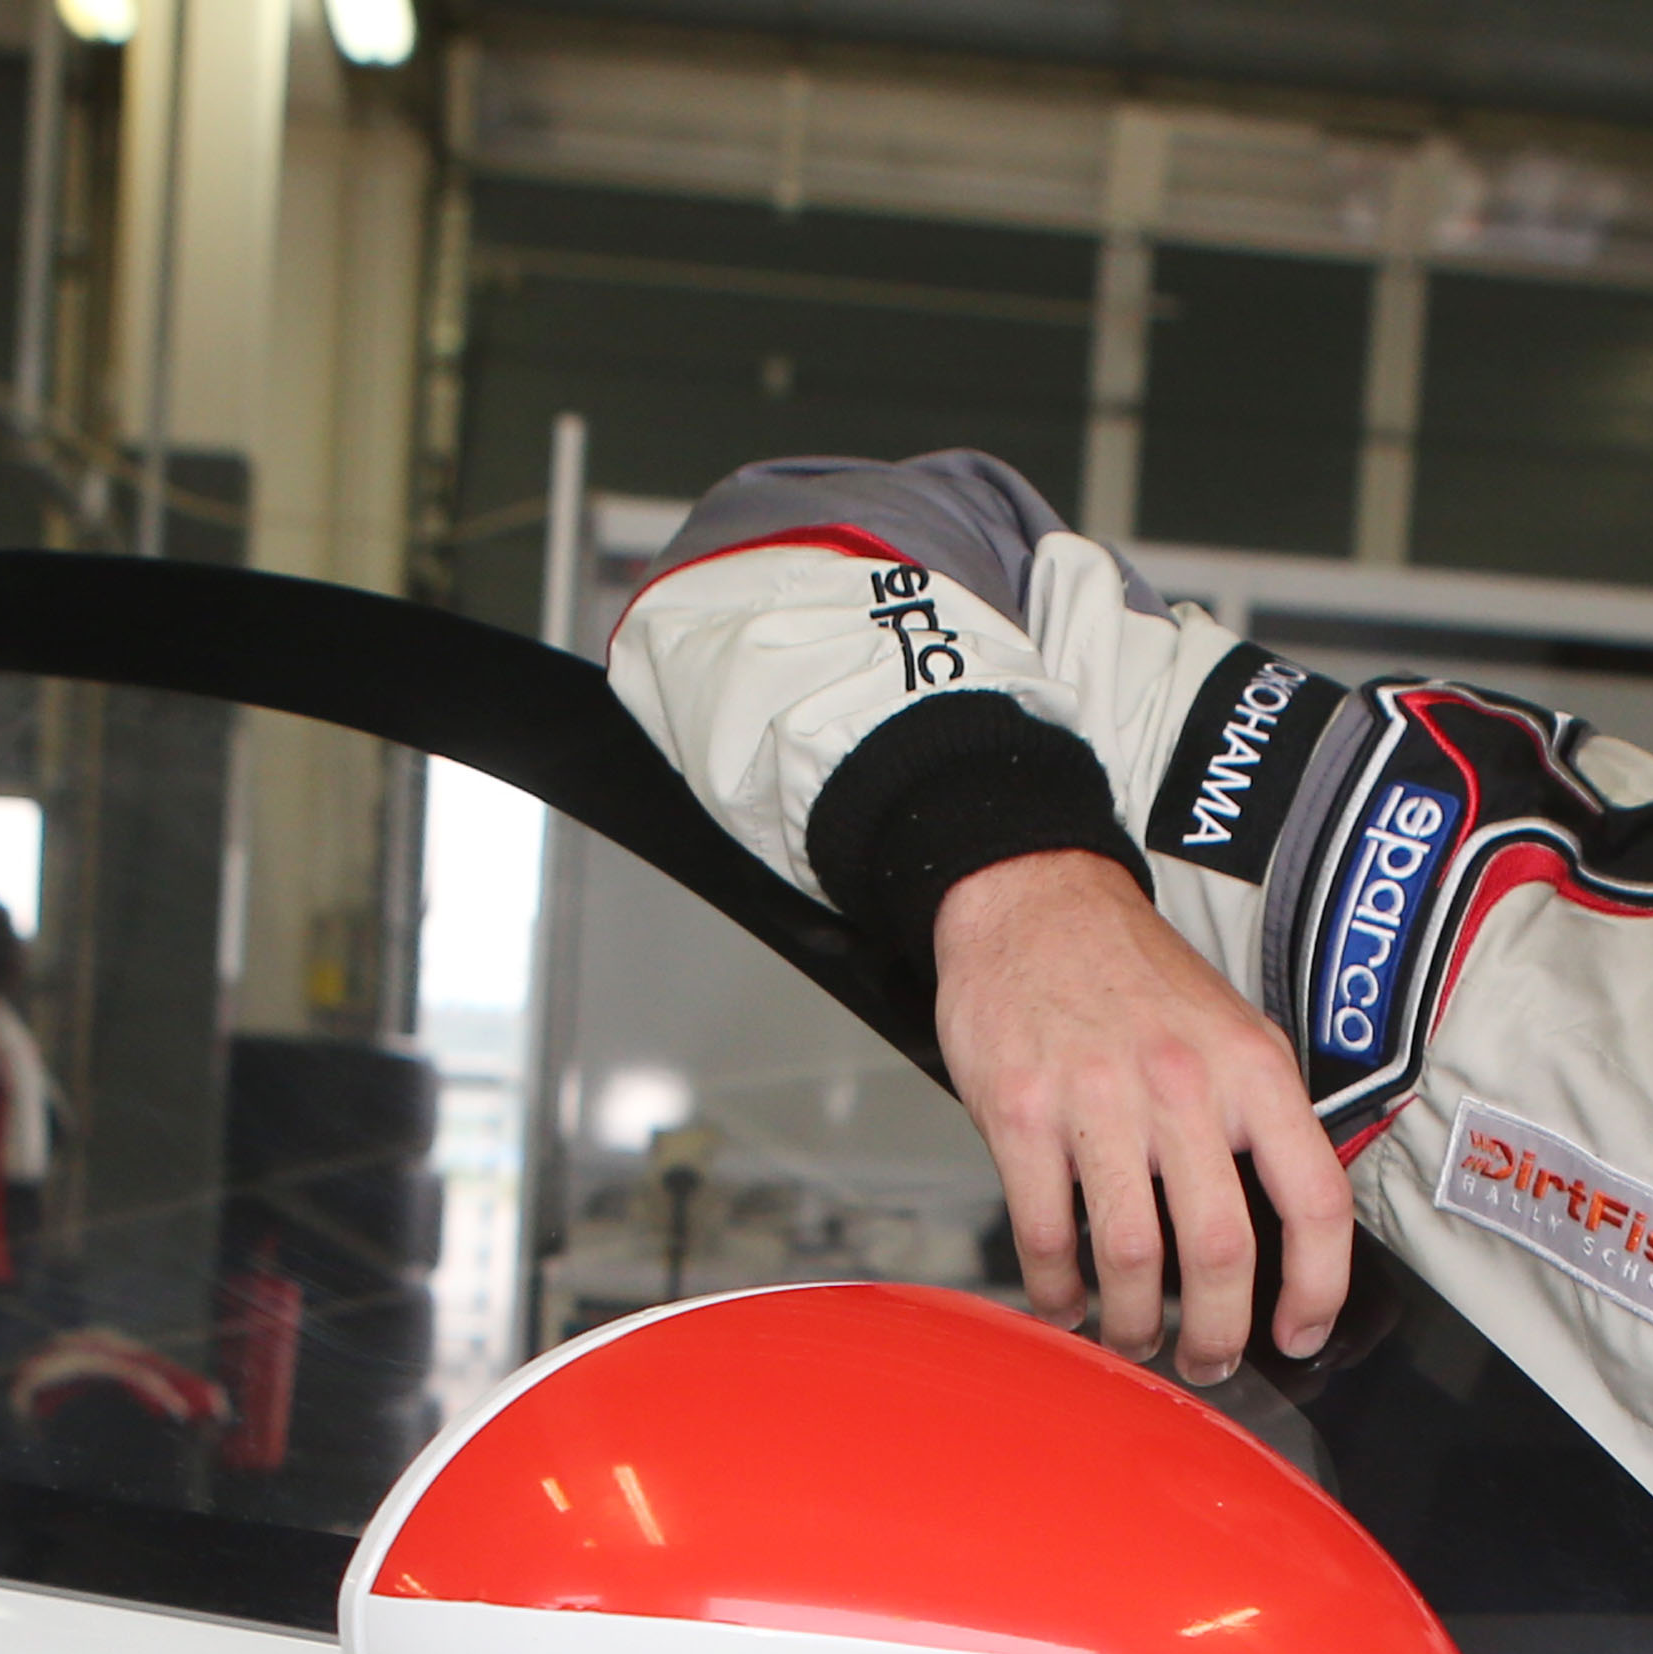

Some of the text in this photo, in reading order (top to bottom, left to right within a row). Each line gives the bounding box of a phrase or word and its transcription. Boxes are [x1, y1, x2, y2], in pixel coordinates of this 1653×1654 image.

[1182, 660, 1308, 845] OKOHAMA
[1321, 785, 1443, 1052] sparco
[1462, 1174, 1562, 1232] RALLY
